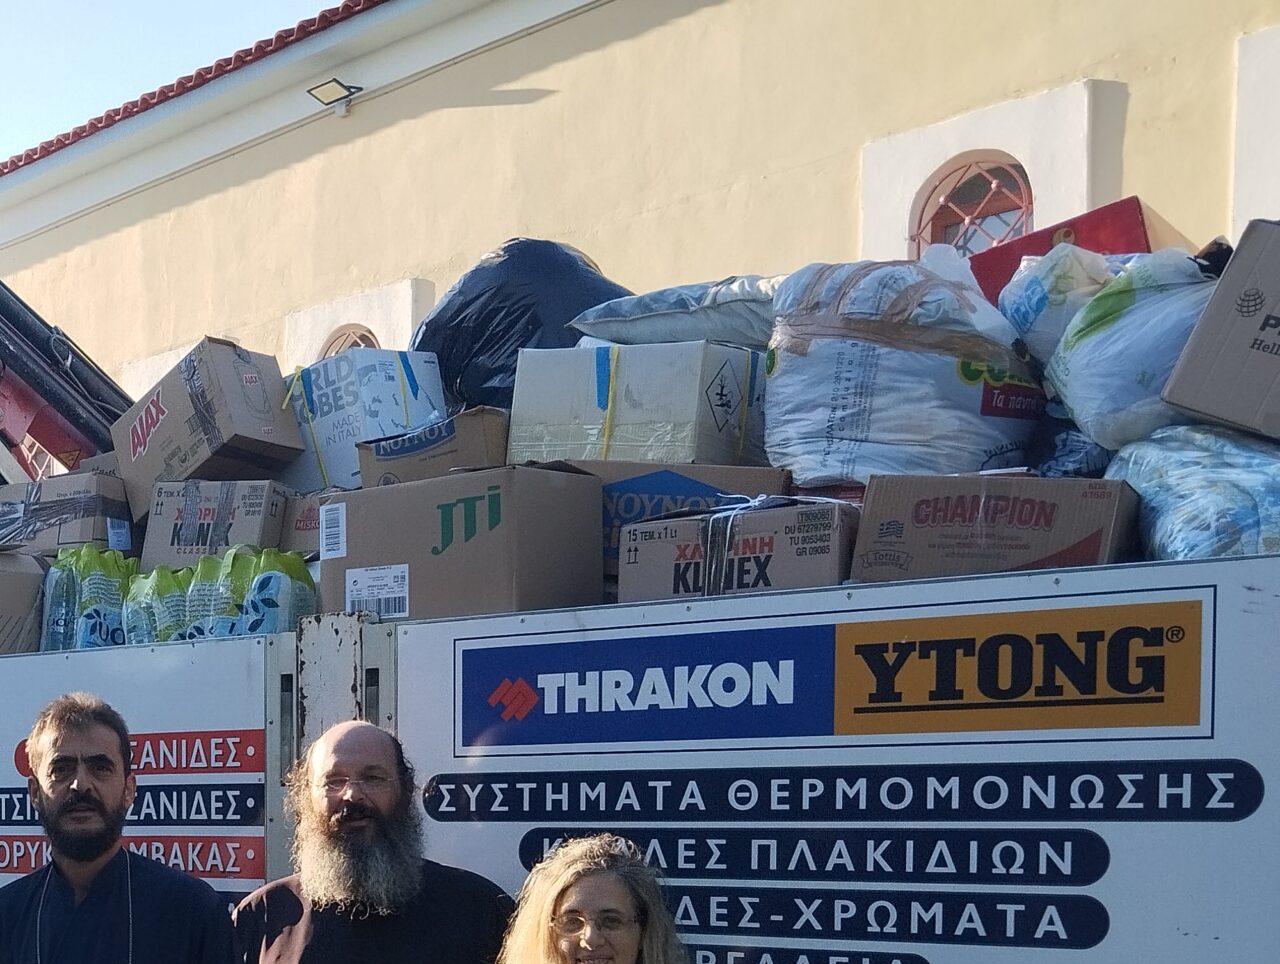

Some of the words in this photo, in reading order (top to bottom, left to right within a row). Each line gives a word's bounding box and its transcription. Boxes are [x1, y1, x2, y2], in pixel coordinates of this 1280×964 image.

[130, 386, 168, 462] AJAX
[325, 434, 337, 446] IN
[339, 426, 361, 442] ITALY
[332, 412, 361, 432] MADE
[785, 525, 795, 534] DU
[911, 494, 1058, 532] CHAMPION
[627, 528, 638, 543] 15
[789, 536, 799, 545] TU
[796, 547, 807, 556] GR
[537, 660, 794, 715] THRAKON
[129, 737, 241, 770] ΣΑΝΙΔΕΣ
[437, 779, 707, 813] ΣΥΣΤΗΜΑΤΑ
[726, 772, 1235, 812] ΘΕΡΜΟΜΟΝΩΣΗΣ
[750, 839, 1073, 875] ΠΛΑΚΙΔΙΩΝ
[675, 895, 1069, 940] ΔΕΣ-ΧΡΩΜΑΤΑ
